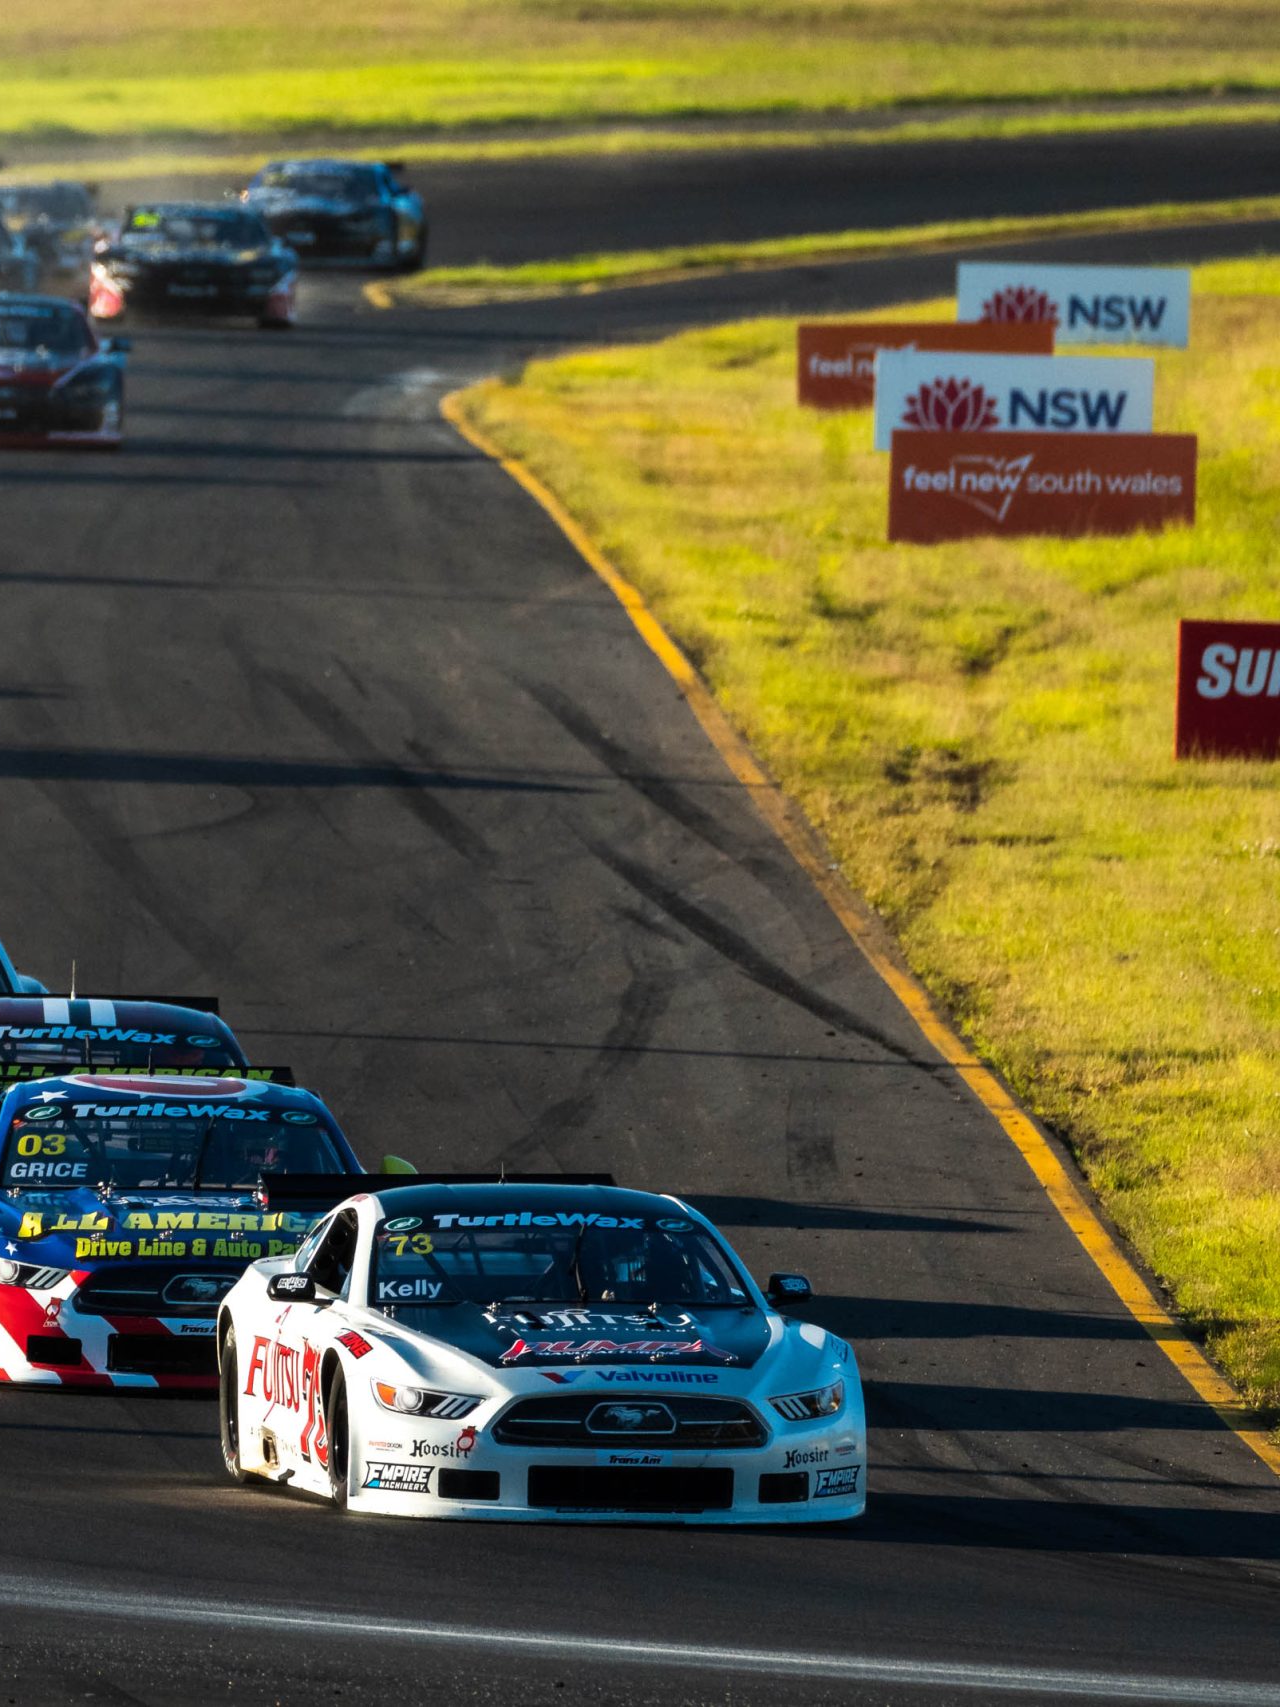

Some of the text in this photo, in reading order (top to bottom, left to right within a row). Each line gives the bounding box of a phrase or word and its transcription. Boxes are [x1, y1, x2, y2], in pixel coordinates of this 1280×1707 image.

[1067, 294, 1167, 331] NSW
[809, 351, 852, 378] feel
[1008, 388, 1127, 429] NSW
[903, 466, 1182, 496] feel new south wales
[72, 1104, 270, 1121] TurtleWax
[17, 1135, 66, 1157] 03
[10, 1162, 88, 1178] GRICE
[18, 1211, 111, 1238] ALL
[432, 1212, 645, 1230] TurtleWax
[75, 1238, 131, 1258] Drive
[139, 1238, 185, 1257] Line
[192, 1238, 207, 1256] &
[213, 1238, 261, 1258] Auto
[388, 1233, 434, 1256] 73
[378, 1279, 442, 1298] Kelly
[180, 1324, 210, 1333] Trans
[595, 1370, 719, 1384] Valvoline
[609, 1454, 663, 1465] Trans Am
[782, 1448, 830, 1469] Hoosier
[365, 1463, 431, 1485] EMPIRE
